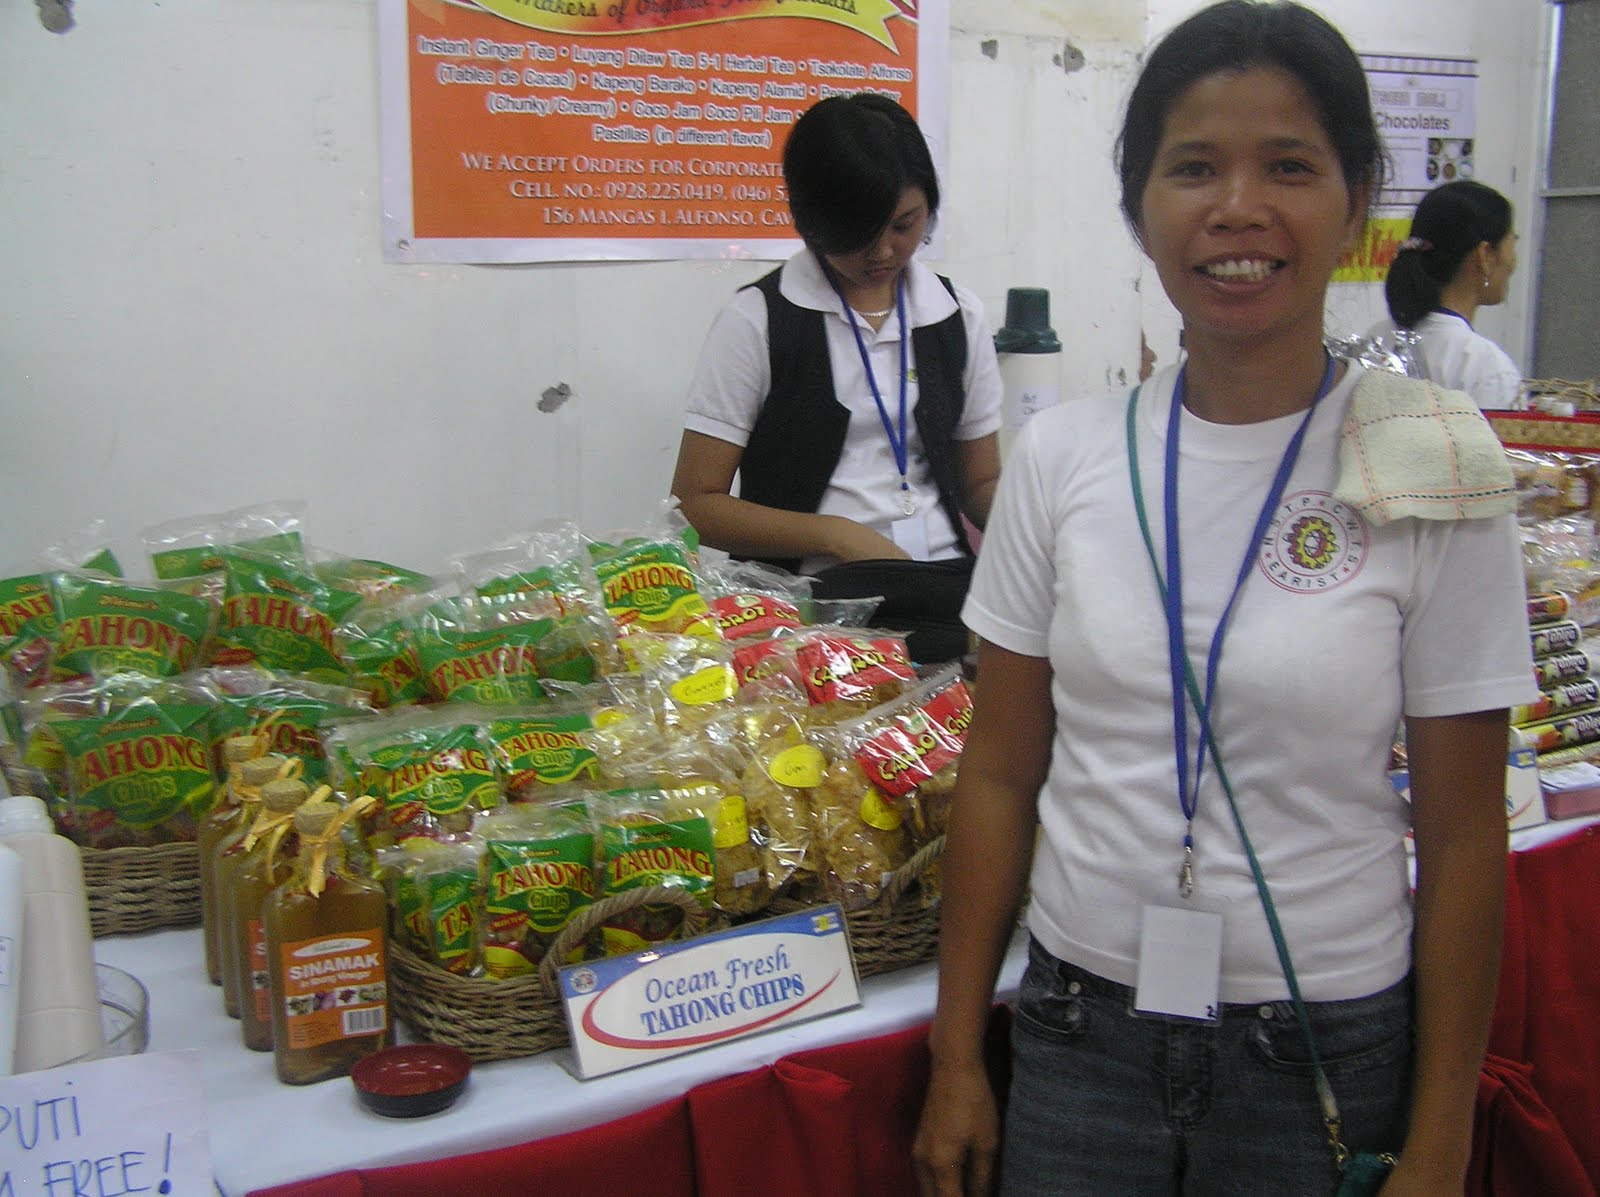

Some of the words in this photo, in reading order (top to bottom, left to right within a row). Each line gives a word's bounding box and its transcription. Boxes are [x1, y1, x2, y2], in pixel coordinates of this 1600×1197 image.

[417, 36, 471, 56] Instant
[475, 39, 525, 61] Ginger
[527, 42, 557, 61] Tea
[571, 45, 624, 68] Luyang
[627, 48, 666, 67] Dilaw
[669, 51, 696, 69] Tea
[698, 52, 721, 70] 5-1
[724, 54, 767, 73] Herbal
[769, 56, 796, 75] Tea
[808, 59, 867, 79] Tsokolate
[868, 64, 913, 82] Alfonso
[437, 62, 496, 84] (Tablea
[499, 69, 520, 85] de
[523, 68, 577, 91] Cacao)
[592, 71, 645, 95] Kapeng
[648, 75, 697, 94] Barako
[709, 78, 760, 100] Kapeng
[762, 81, 807, 99] Alamid
[633, 99, 670, 118] Coco
[673, 102, 702, 120] Jam
[704, 103, 740, 121] Coco
[765, 106, 793, 124] Jam
[1375, 111, 1451, 130] Chocolates
[593, 124, 650, 143] Pastillas
[653, 124, 674, 146] (in
[676, 126, 729, 145] different
[731, 129, 773, 149] flavor)
[461, 152, 493, 171] WE
[498, 154, 568, 173] ACCEPT
[572, 155, 645, 174] ORDERS
[650, 159, 685, 175] FOR
[544, 206, 575, 224] 156
[578, 207, 656, 226] MANGAS
[607, 565, 695, 603] TAHONG
[0, 592, 55, 637] TAH
[225, 594, 345, 660] TAHON
[433, 646, 539, 697] TAHON
[78, 735, 209, 793] AHONG
[496, 862, 594, 901] TAHONG
[613, 846, 713, 883] TAHONG
[288, 952, 381, 981] SINAMAK
[645, 968, 720, 1004] Ocean
[725, 943, 792, 990] Fresh
[639, 987, 738, 1036] TAHONG
[739, 972, 807, 1013] CHIPS
